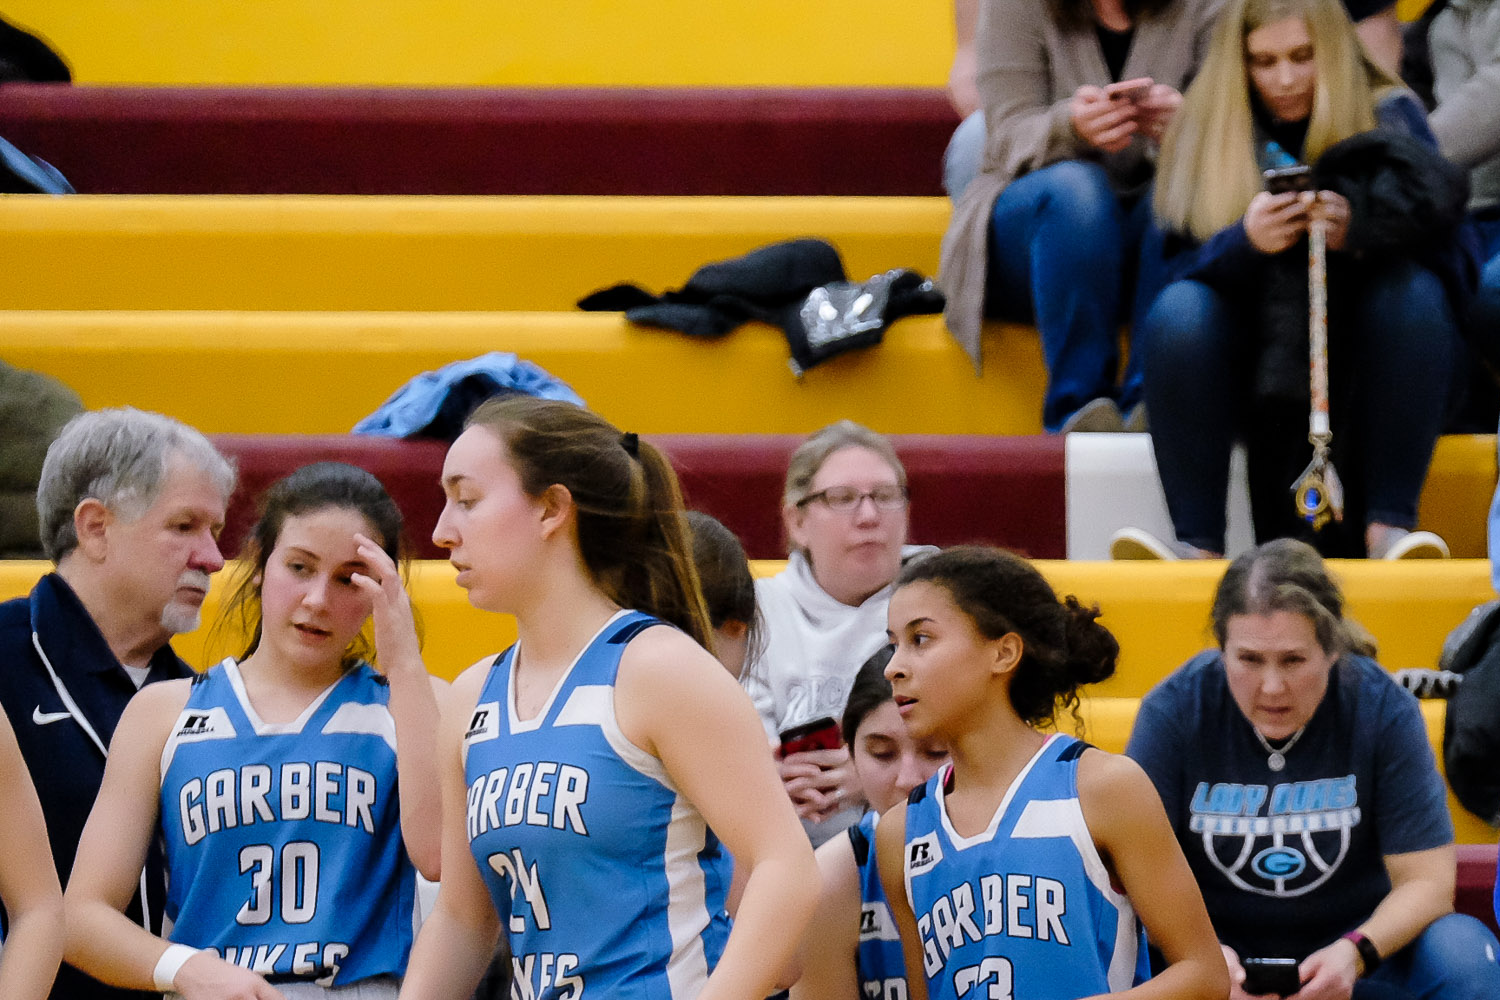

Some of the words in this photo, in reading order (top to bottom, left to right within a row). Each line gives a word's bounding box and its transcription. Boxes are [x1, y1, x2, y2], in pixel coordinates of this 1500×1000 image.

[179, 760, 377, 847] GARBER
[467, 761, 590, 843] ARBER
[235, 840, 320, 926] 30
[917, 872, 1072, 979] GARBER
